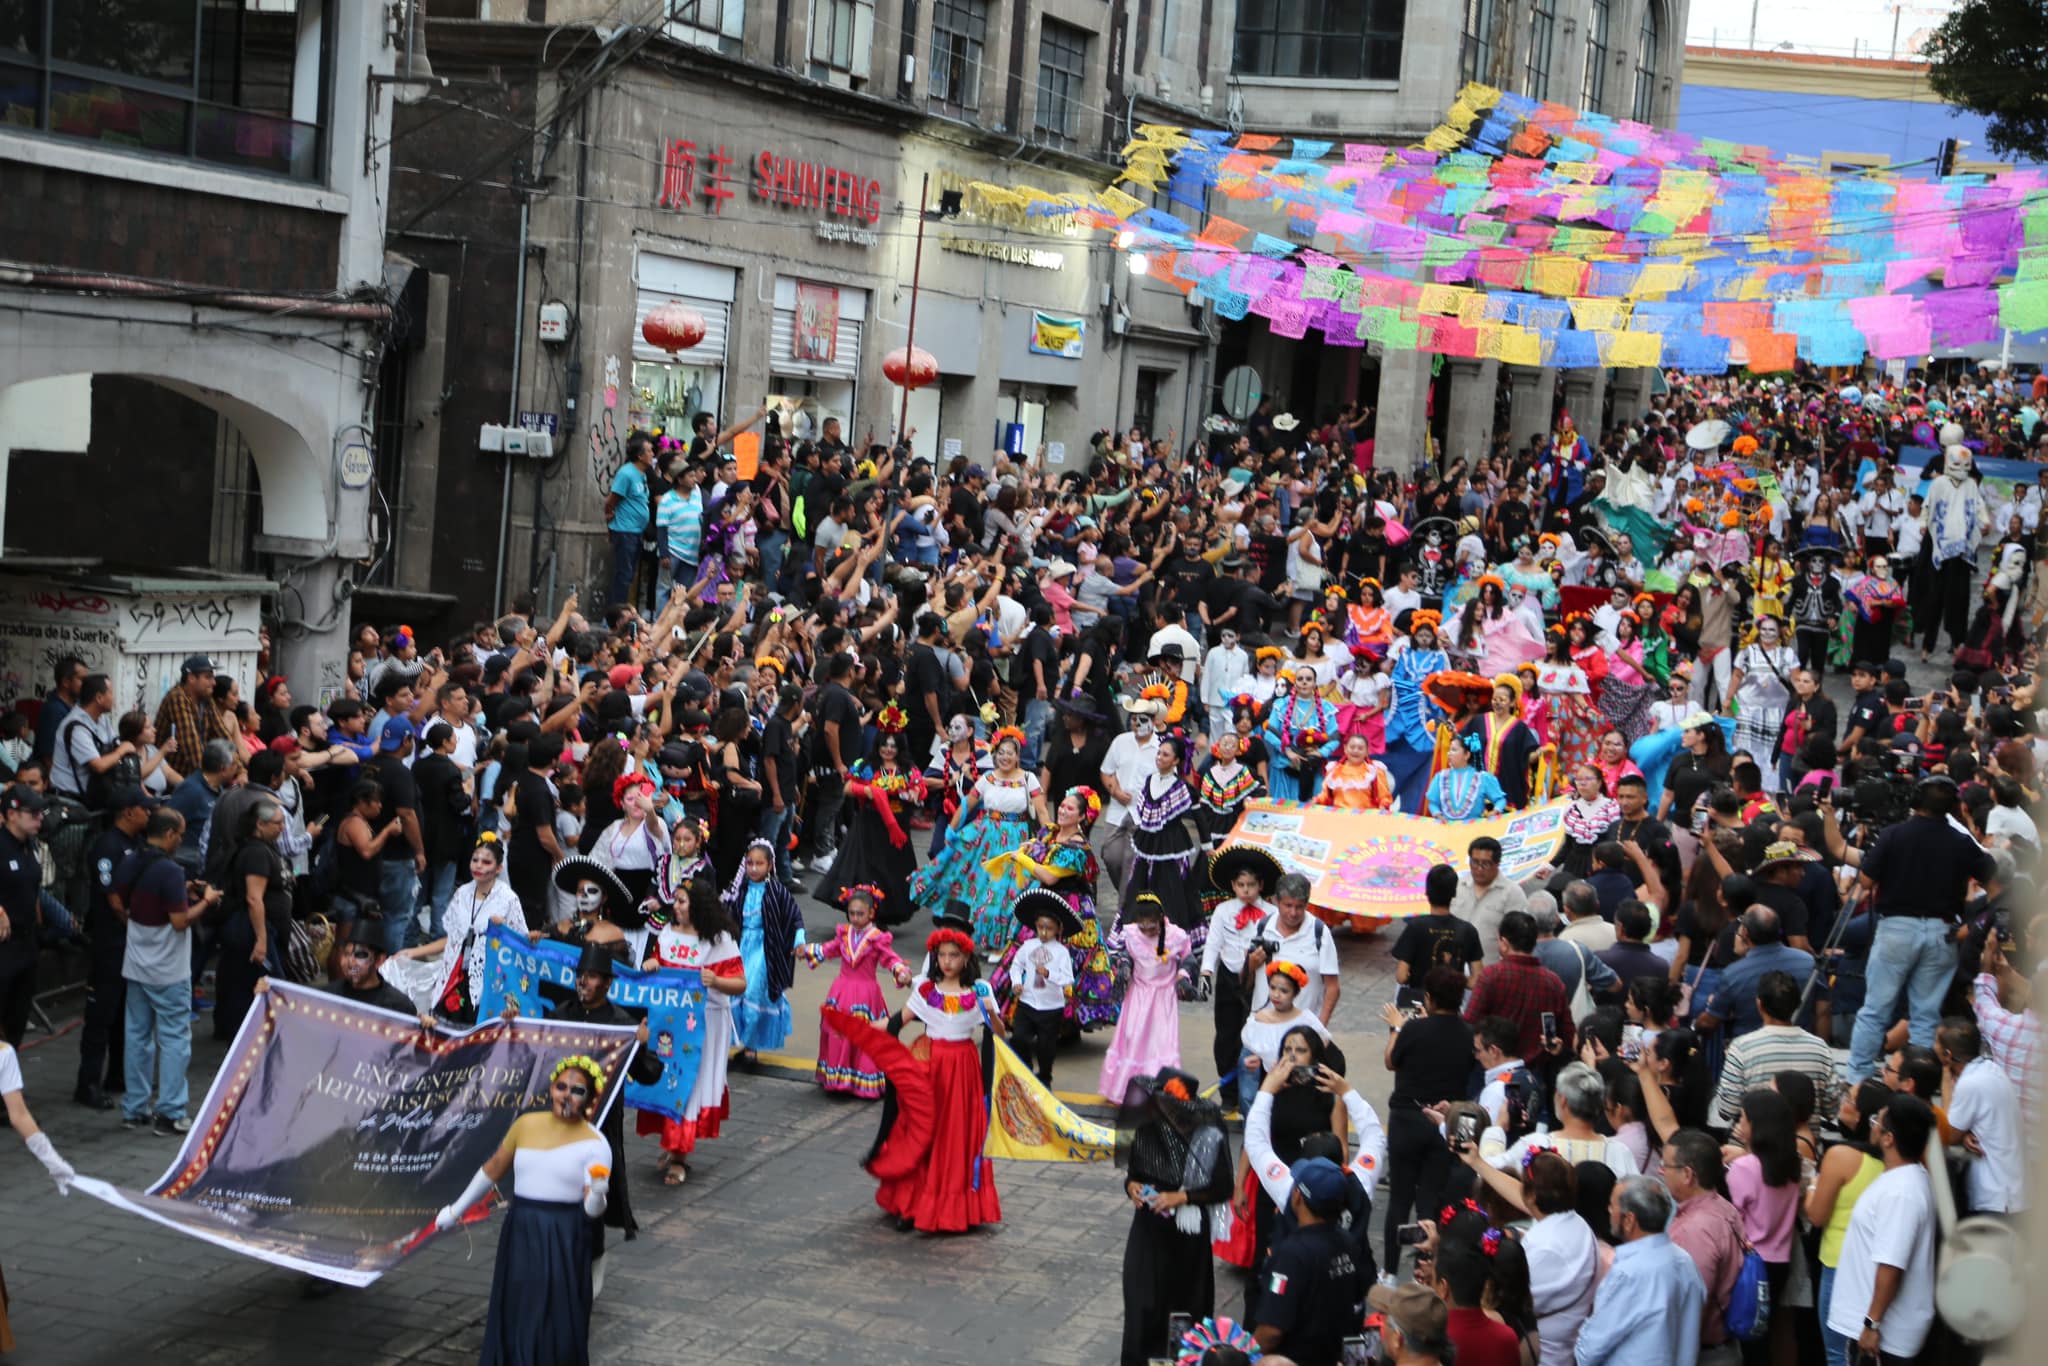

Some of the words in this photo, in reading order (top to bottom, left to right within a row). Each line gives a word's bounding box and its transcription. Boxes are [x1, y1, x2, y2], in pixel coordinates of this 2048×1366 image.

[660, 136, 736, 215] 顺丰
[45, 625, 58, 640] de
[61, 625, 70, 641] la
[498, 946, 553, 980] CASA
[606, 982, 695, 1009] ULTURA
[307, 1071, 424, 1112] ARTISTAS
[353, 1061, 486, 1093] ENCUENTRO
[491, 1066, 524, 1087] DE
